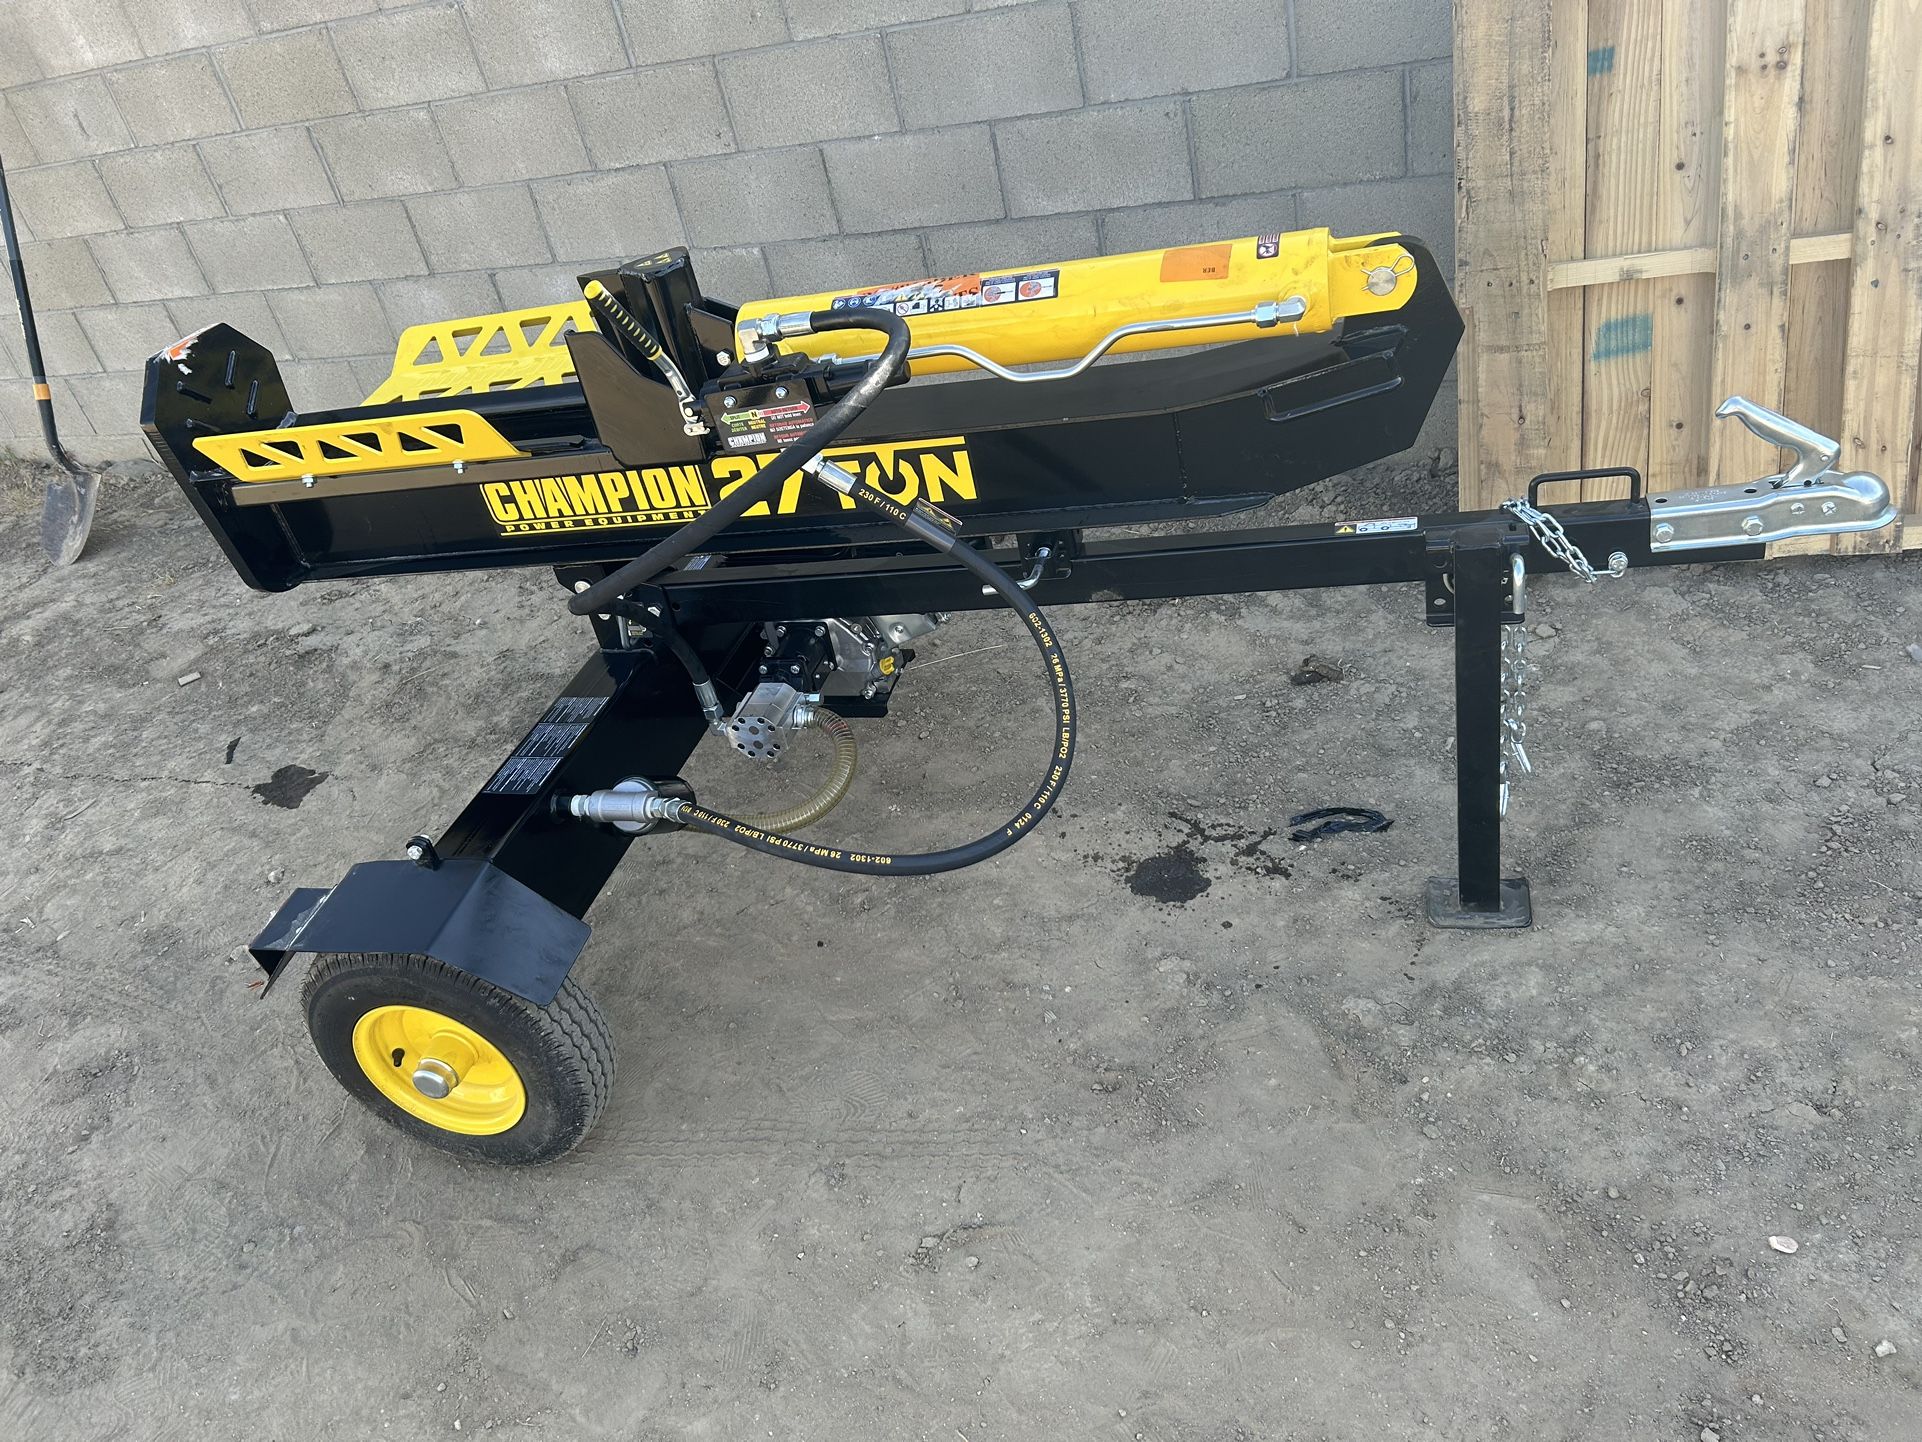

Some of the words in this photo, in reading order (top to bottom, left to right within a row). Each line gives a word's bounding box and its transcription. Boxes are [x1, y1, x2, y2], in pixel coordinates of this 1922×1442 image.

[750, 410, 758, 418] N
[727, 432, 767, 447] CHAMPION
[800, 436, 978, 511] TON
[484, 465, 707, 522] CHAMPION
[858, 488, 874, 501] 230
[885, 503, 899, 516] 110
[899, 512, 907, 520] C
[505, 520, 575, 533] POWER
[585, 509, 707, 526] EQUIPMENT
[1028, 612, 1053, 648] 602-1302
[1050, 653, 1060, 664] 26
[1053, 664, 1064, 683] MPa
[1059, 687, 1070, 708] 3770
[1062, 709, 1071, 723] PSI
[1058, 727, 1070, 759] LB/PO2
[1051, 765, 1063, 780] 230
[1038, 790, 1051, 804] 110
[1033, 802, 1042, 810] C
[716, 818, 731, 828] 230
[1014, 812, 1032, 829] 0124
[734, 824, 765, 840] LB/PO2
[766, 835, 782, 845] PSI
[782, 840, 804, 851] 3770
[809, 846, 829, 857] MPa
[830, 850, 842, 859] 26
[850, 853, 892, 865] 602-1302
